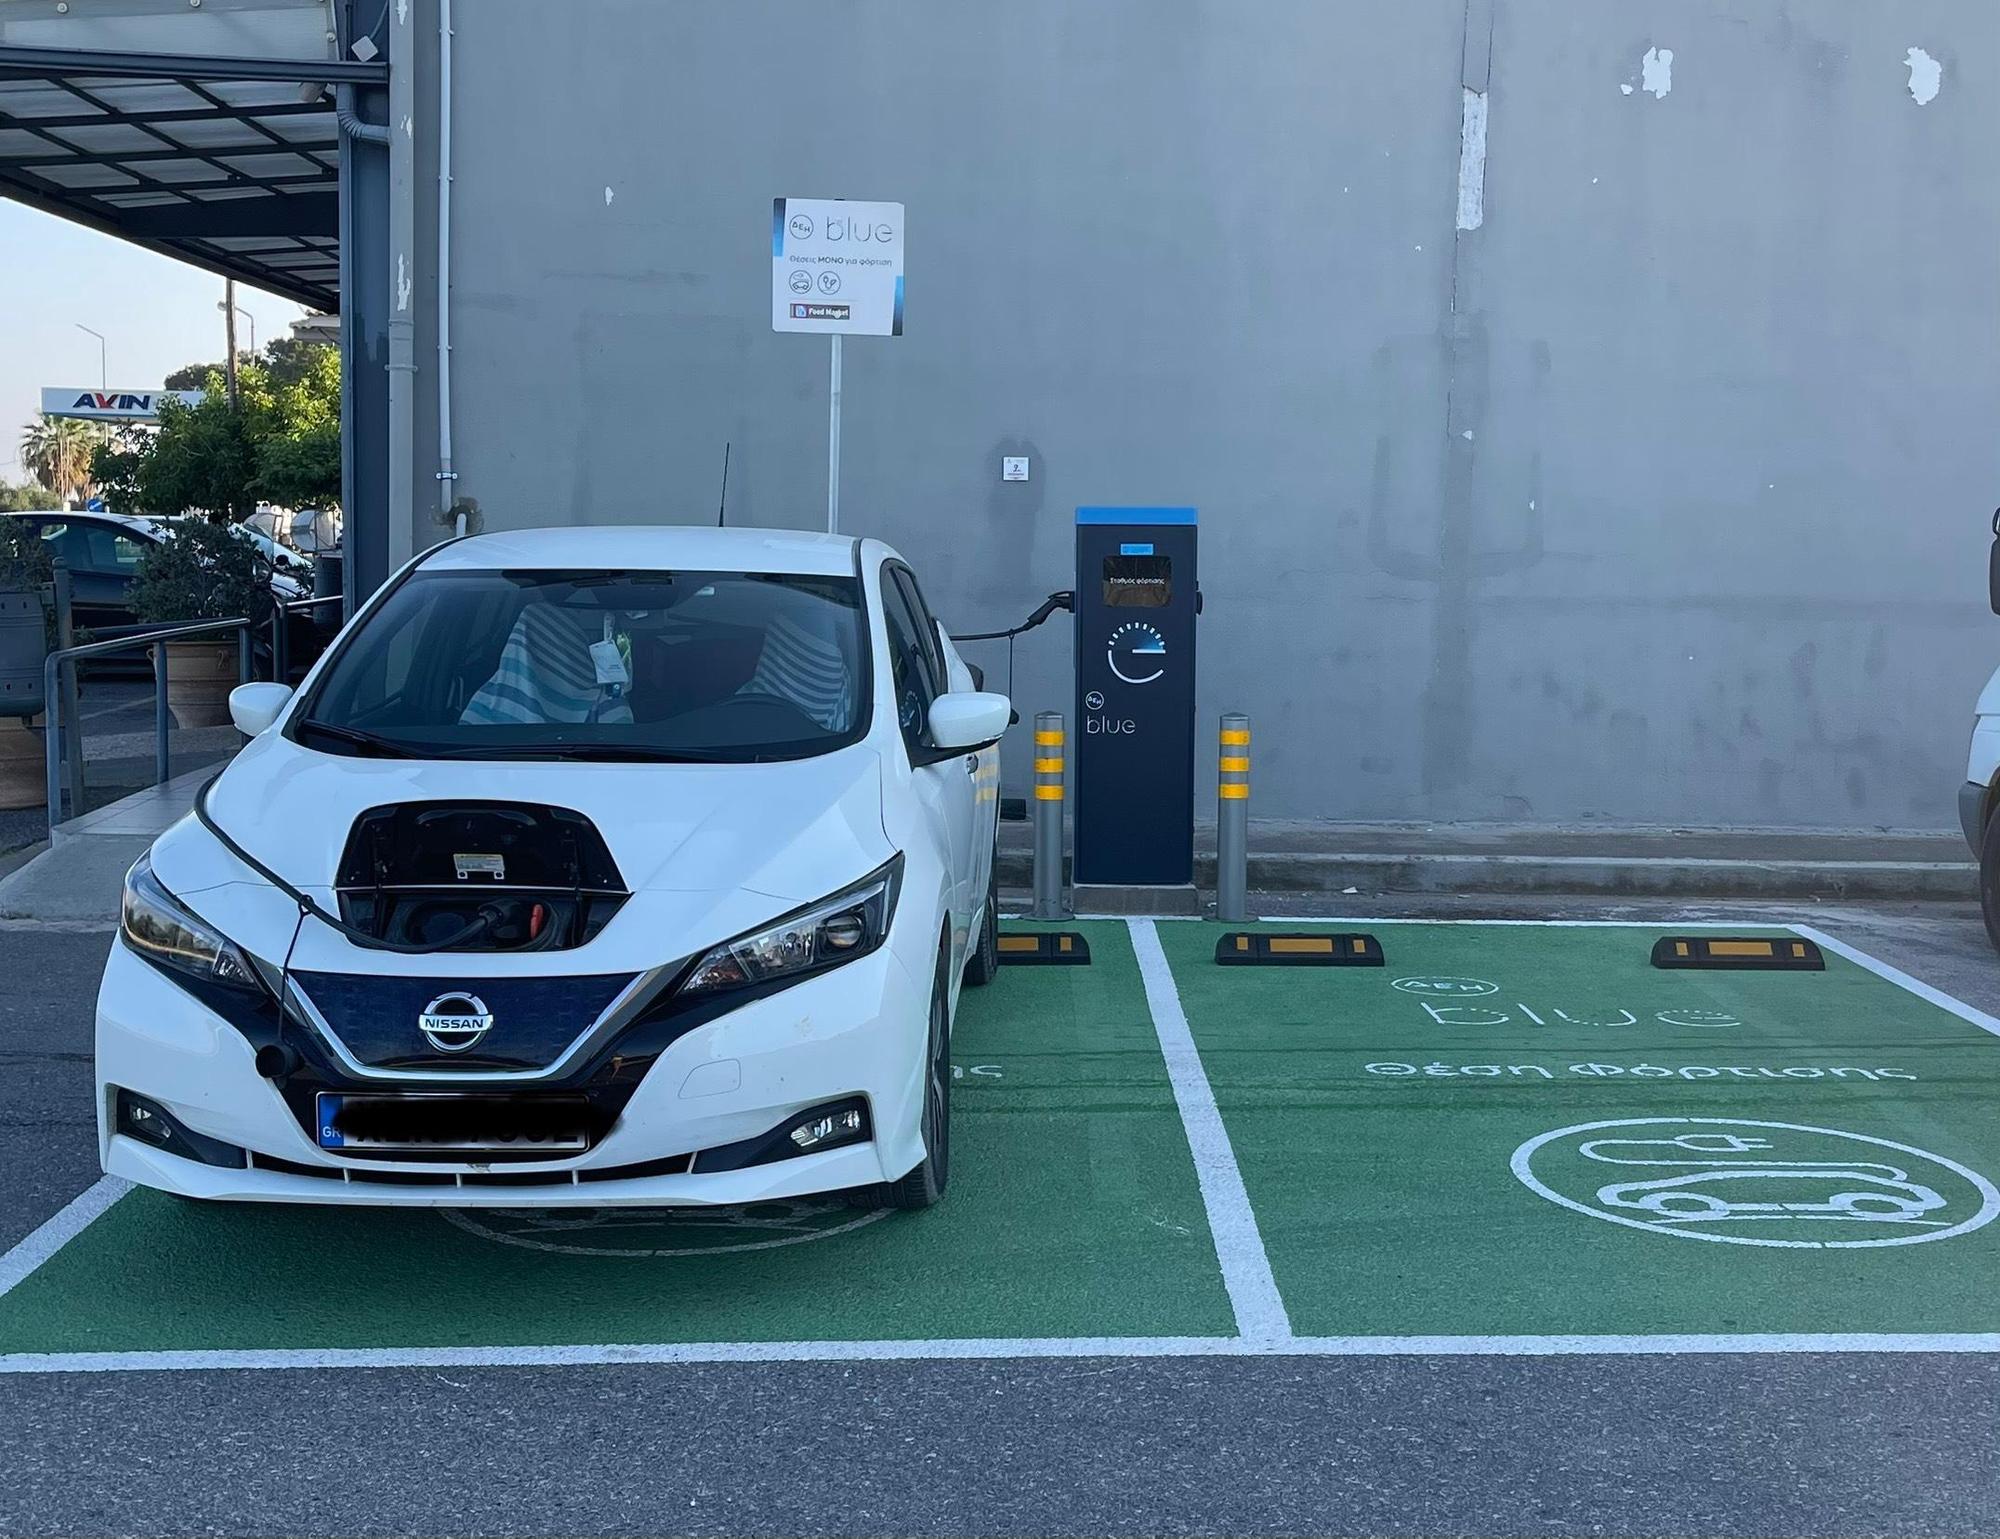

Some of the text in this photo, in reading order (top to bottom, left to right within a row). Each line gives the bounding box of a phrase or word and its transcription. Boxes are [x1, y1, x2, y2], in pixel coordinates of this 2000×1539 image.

[791, 221, 811, 233] ΔΕΗ
[826, 216, 893, 243] blue
[817, 256, 844, 265] ΜΟΝΟ
[73, 393, 151, 410] AVIN
[1086, 715, 1136, 734] blue
[1420, 1002, 1742, 1026] blue
[424, 1017, 485, 1030] NISSAN
[1364, 1061, 1917, 1080] Θέση Φόρτισης
